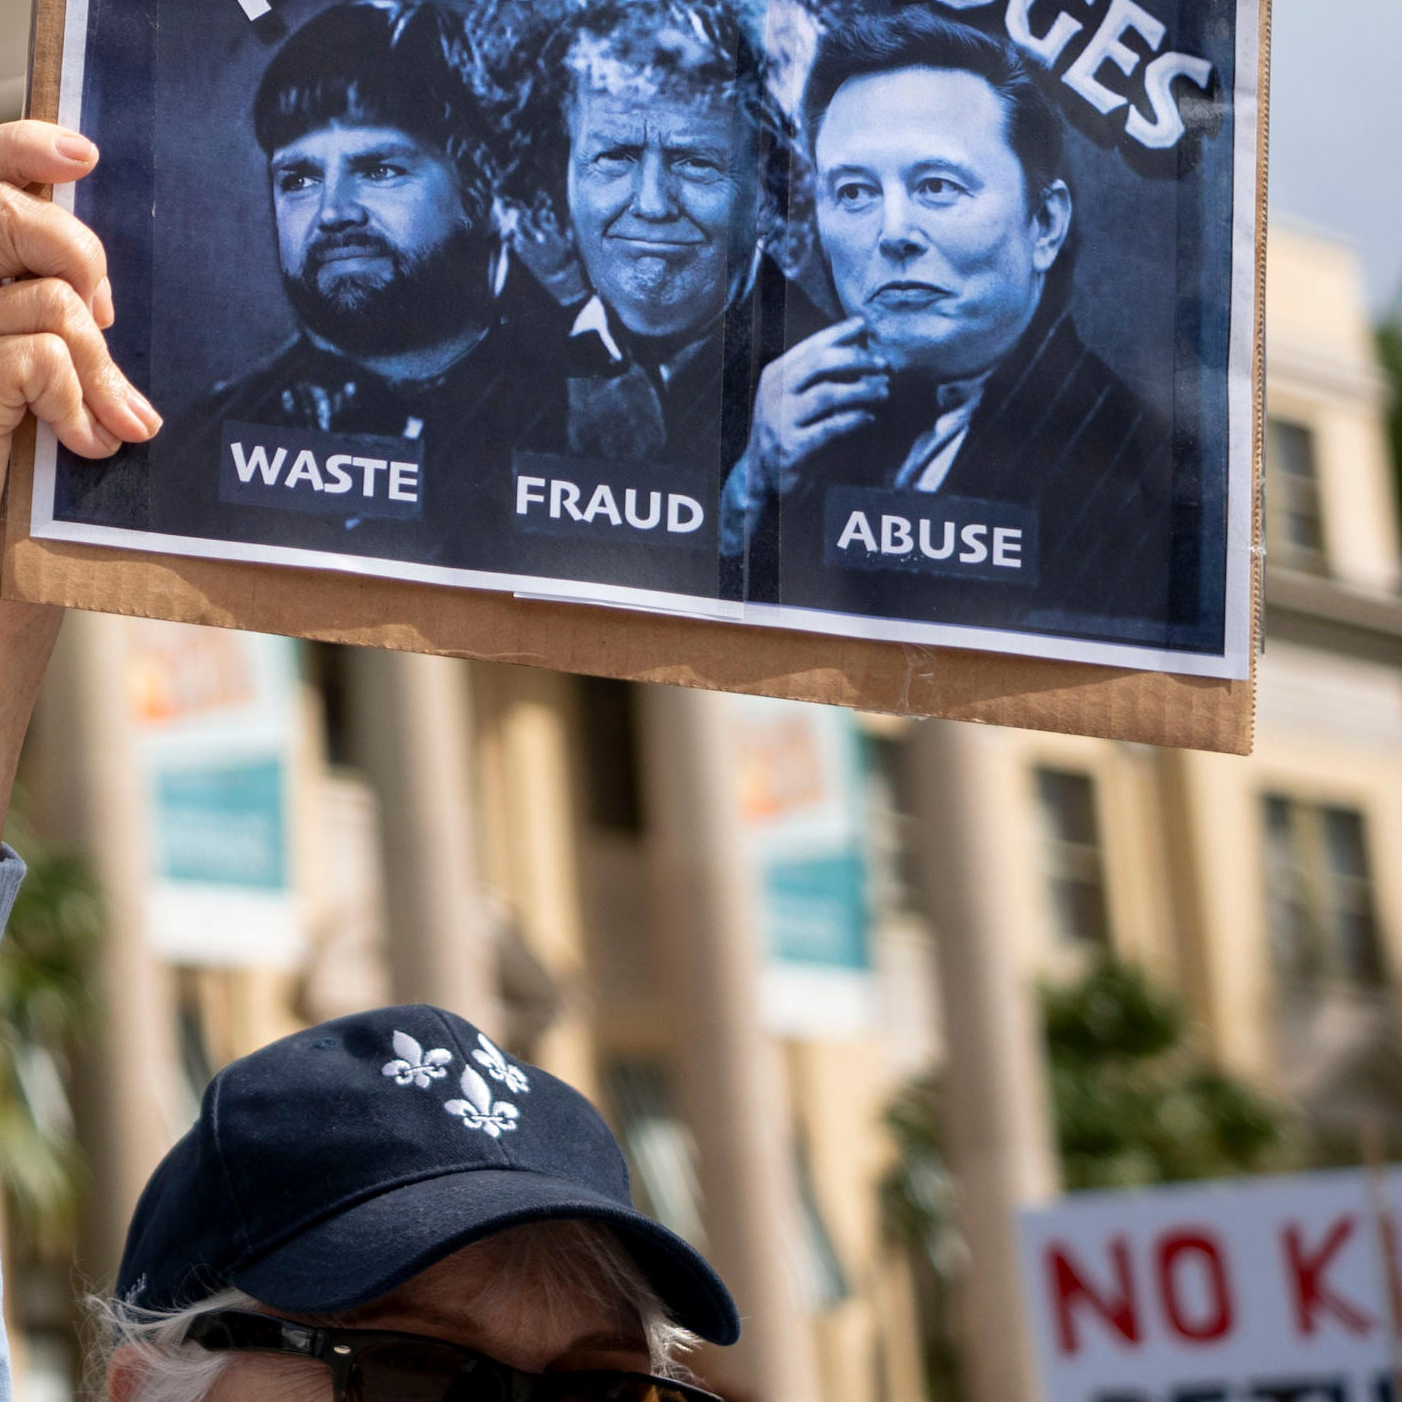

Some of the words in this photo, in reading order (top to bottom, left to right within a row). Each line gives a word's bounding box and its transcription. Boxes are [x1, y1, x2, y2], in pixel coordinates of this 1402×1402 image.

[230, 442, 420, 503] WASTE
[516, 476, 705, 534] FRAUD
[836, 510, 1024, 569] ABUSE
[1044, 1222, 1236, 1356] NO
